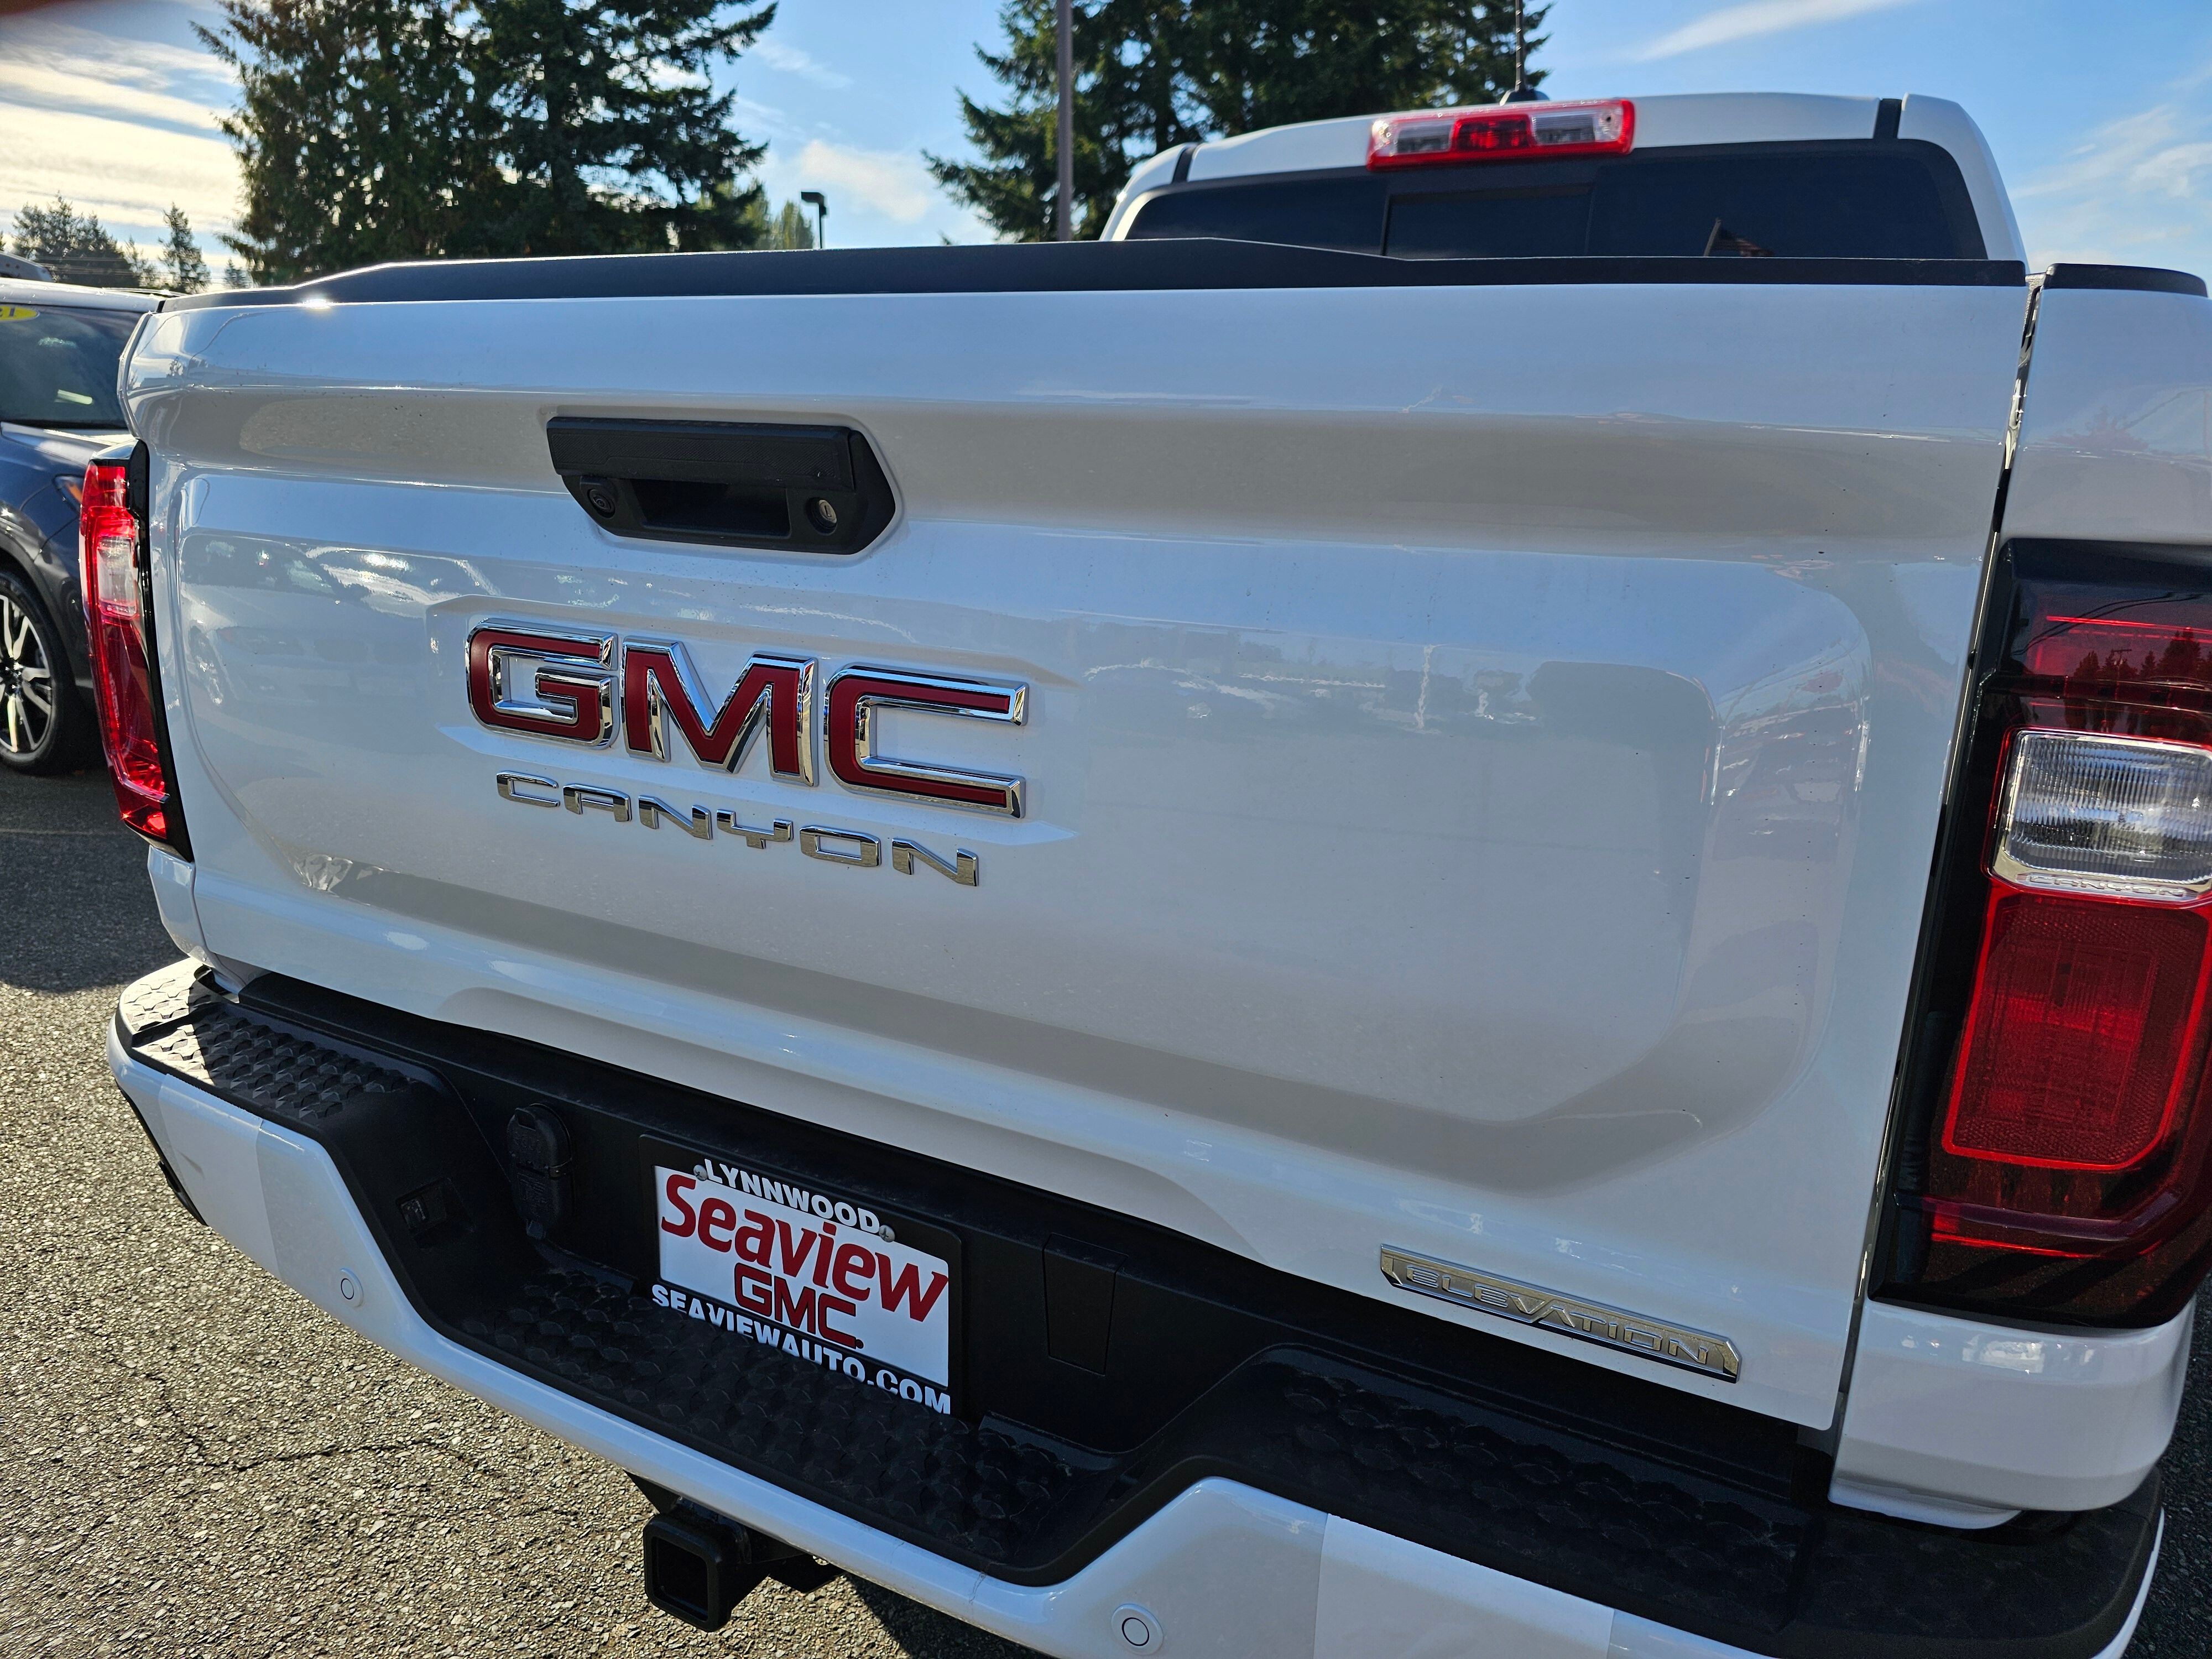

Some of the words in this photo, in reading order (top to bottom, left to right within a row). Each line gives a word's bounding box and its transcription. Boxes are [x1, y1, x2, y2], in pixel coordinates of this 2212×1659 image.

[465, 618, 1029, 819] GMC
[496, 771, 979, 886] CANYON
[661, 1174, 948, 1322] Seaview
[705, 1158, 879, 1234] LYNNWOOD
[652, 1284, 951, 1415] SEAVIEWAUTO.COM
[734, 1262, 858, 1349] GMC
[1407, 1265, 1709, 1365] ELEVATION
